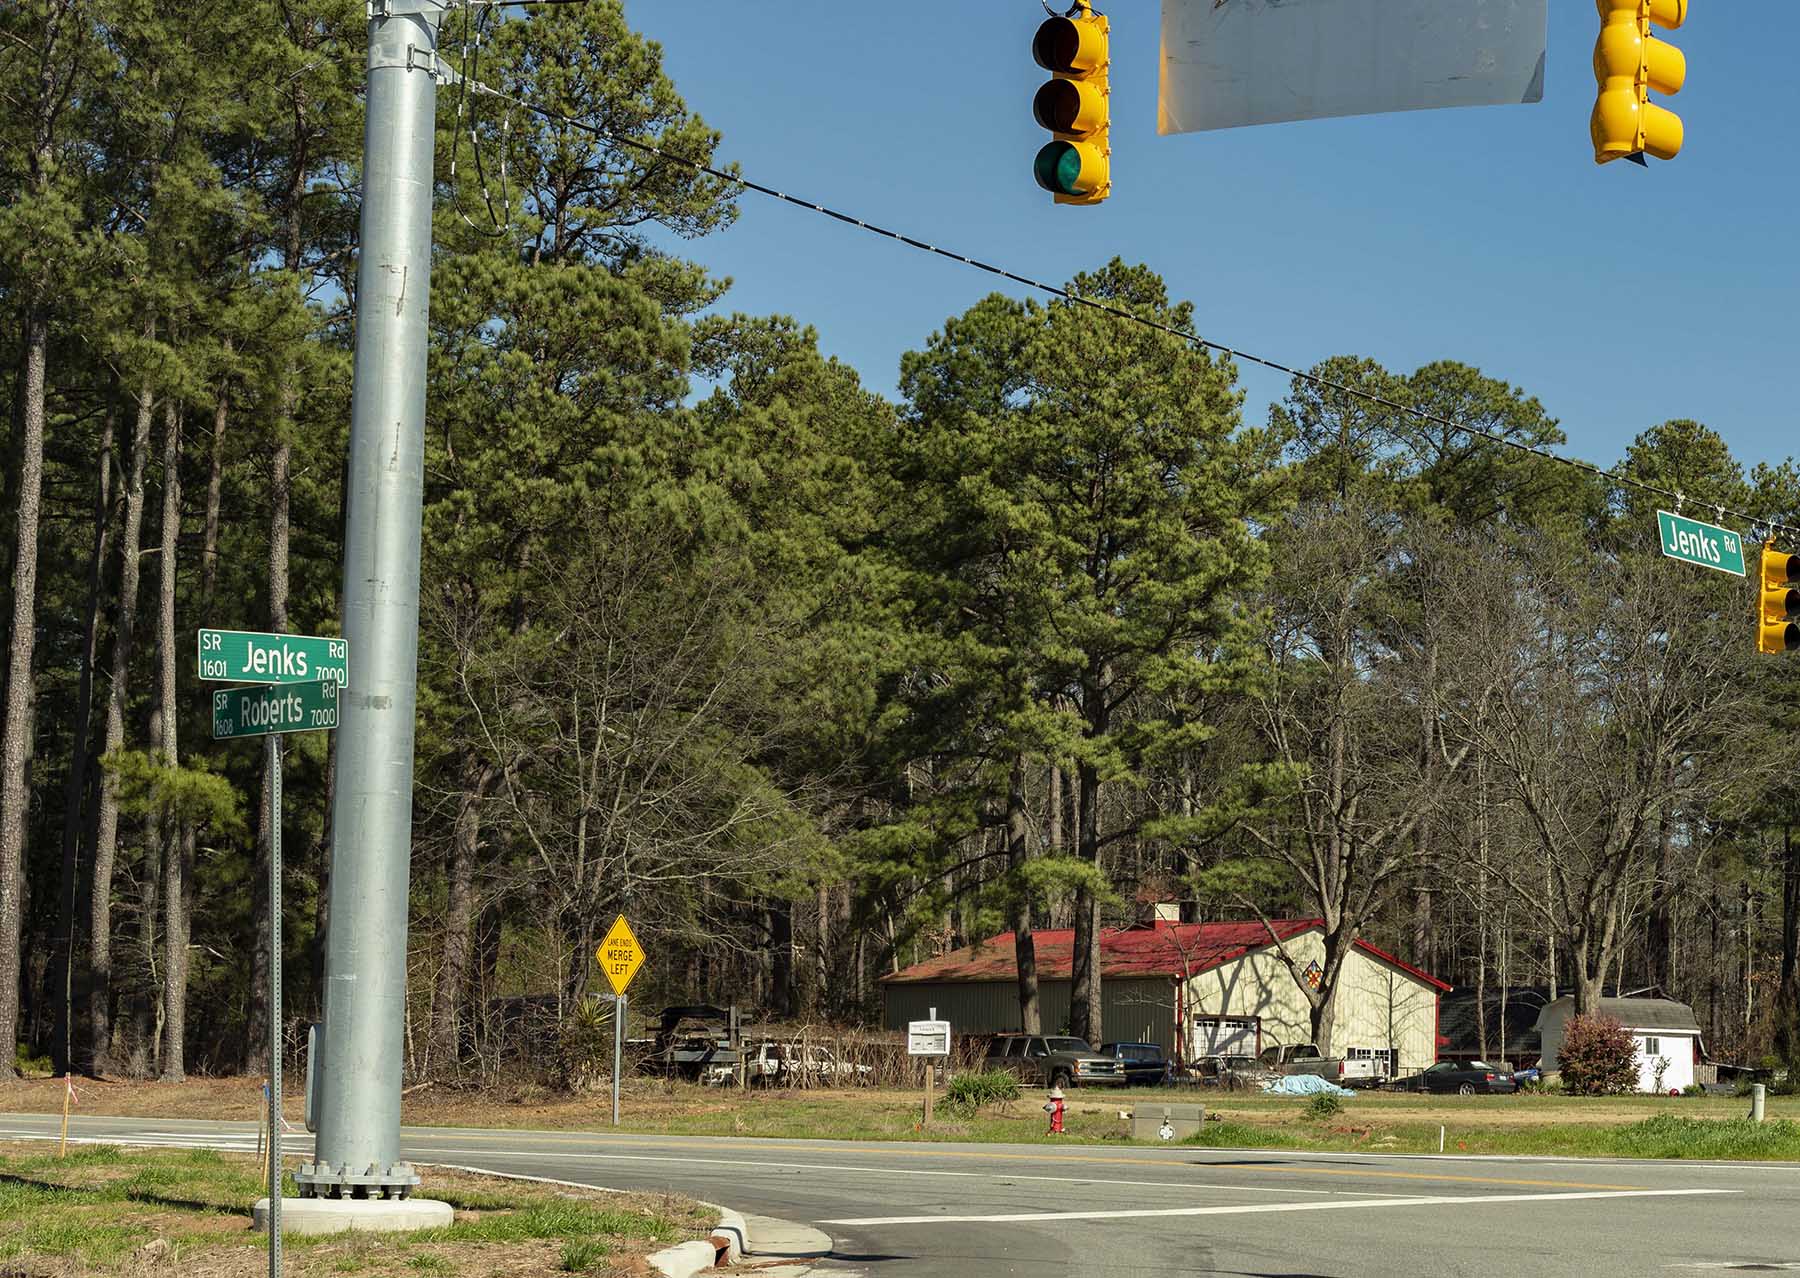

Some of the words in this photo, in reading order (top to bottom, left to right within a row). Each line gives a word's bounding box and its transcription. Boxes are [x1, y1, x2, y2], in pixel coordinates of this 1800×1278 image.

[1669, 521, 1721, 563] Jenks
[1723, 535, 1737, 554] Rd
[203, 633, 222, 651] SR
[242, 641, 308, 676] Jenks
[329, 642, 345, 658] Rd
[203, 660, 227, 677] 1601
[315, 666, 345, 684] 7000
[216, 694, 228, 710] SR
[241, 693, 303, 727] Roberts
[322, 682, 335, 699] Rd
[311, 708, 336, 726] 7000
[608, 950, 633, 961] MERGE
[610, 964, 629, 975] LEFT
